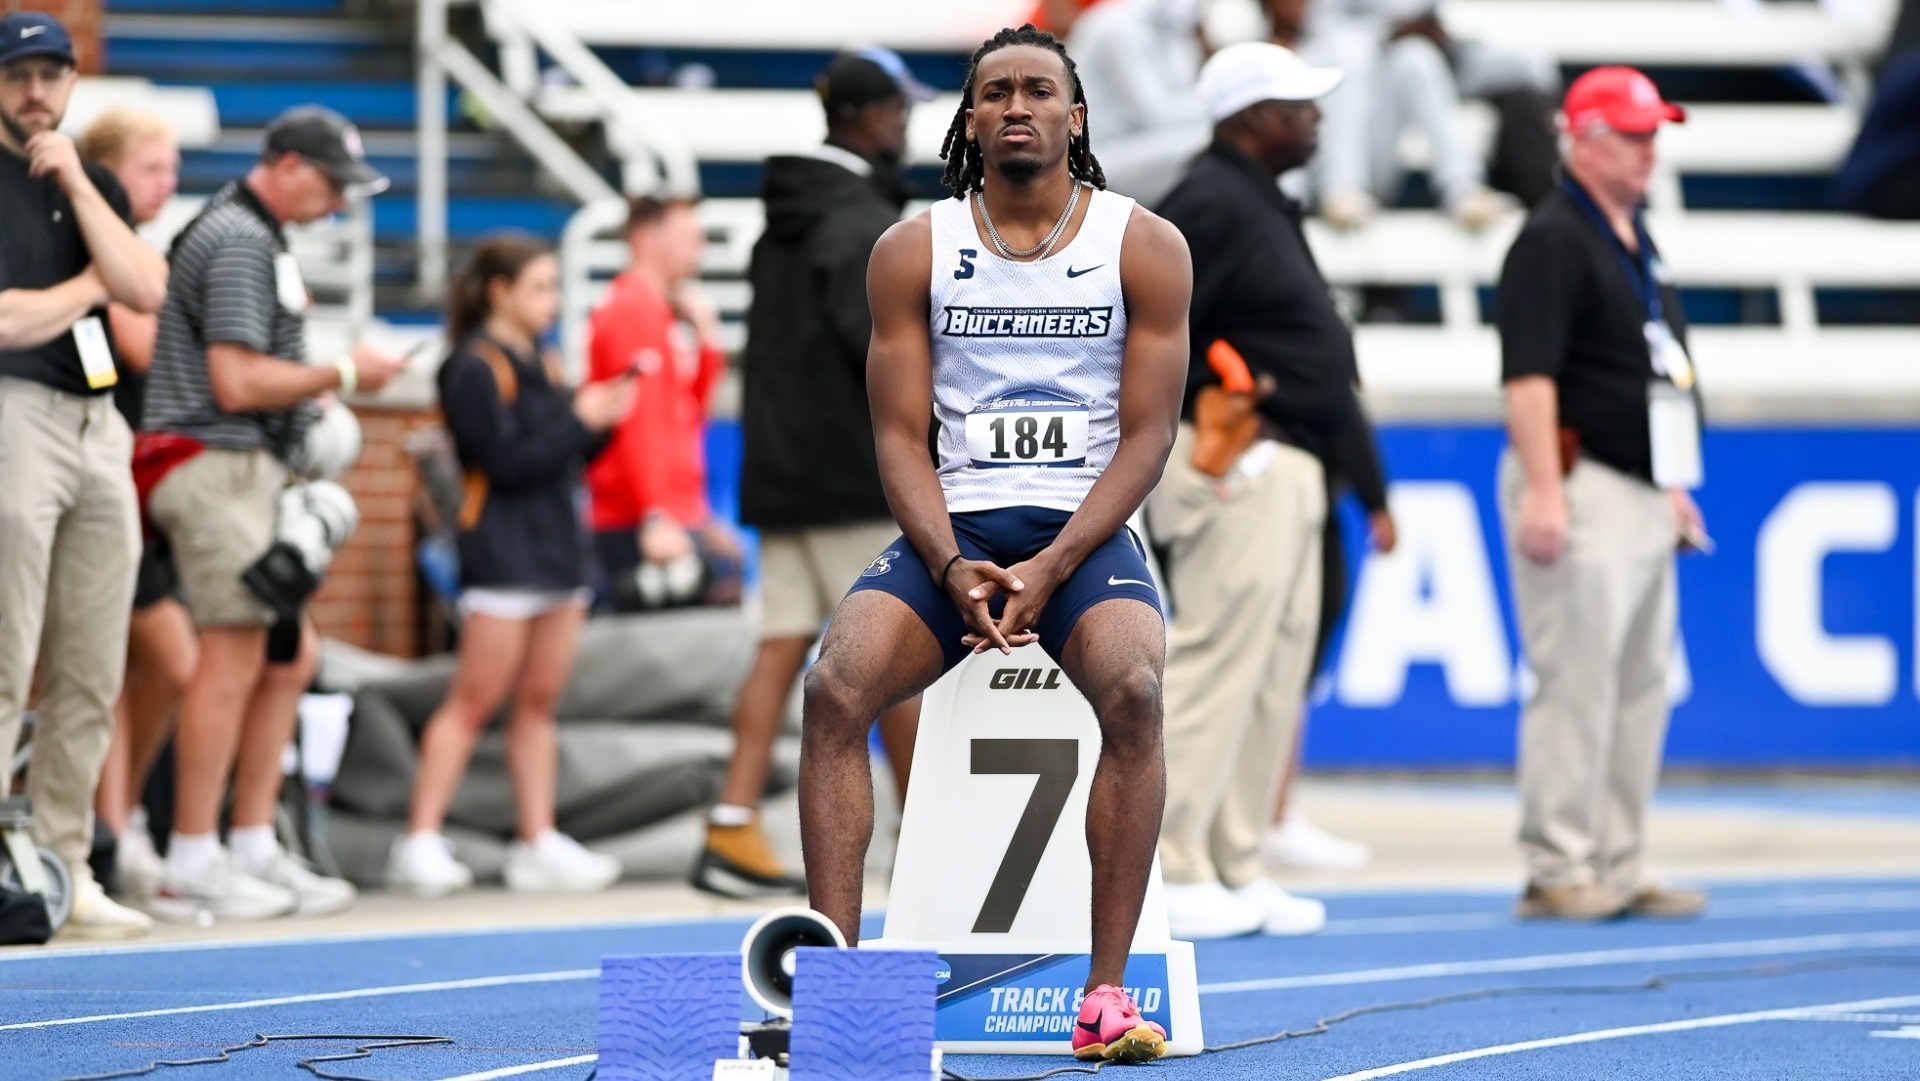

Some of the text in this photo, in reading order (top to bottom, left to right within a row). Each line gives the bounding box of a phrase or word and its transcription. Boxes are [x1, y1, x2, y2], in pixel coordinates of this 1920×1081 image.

[947, 309, 1109, 335] BUCCANEERS
[990, 416, 1067, 459] 184
[989, 668, 1061, 689] GILL
[970, 738, 1079, 933] 7
[935, 971, 951, 979] CAA
[990, 987, 1069, 1013] TRACK
